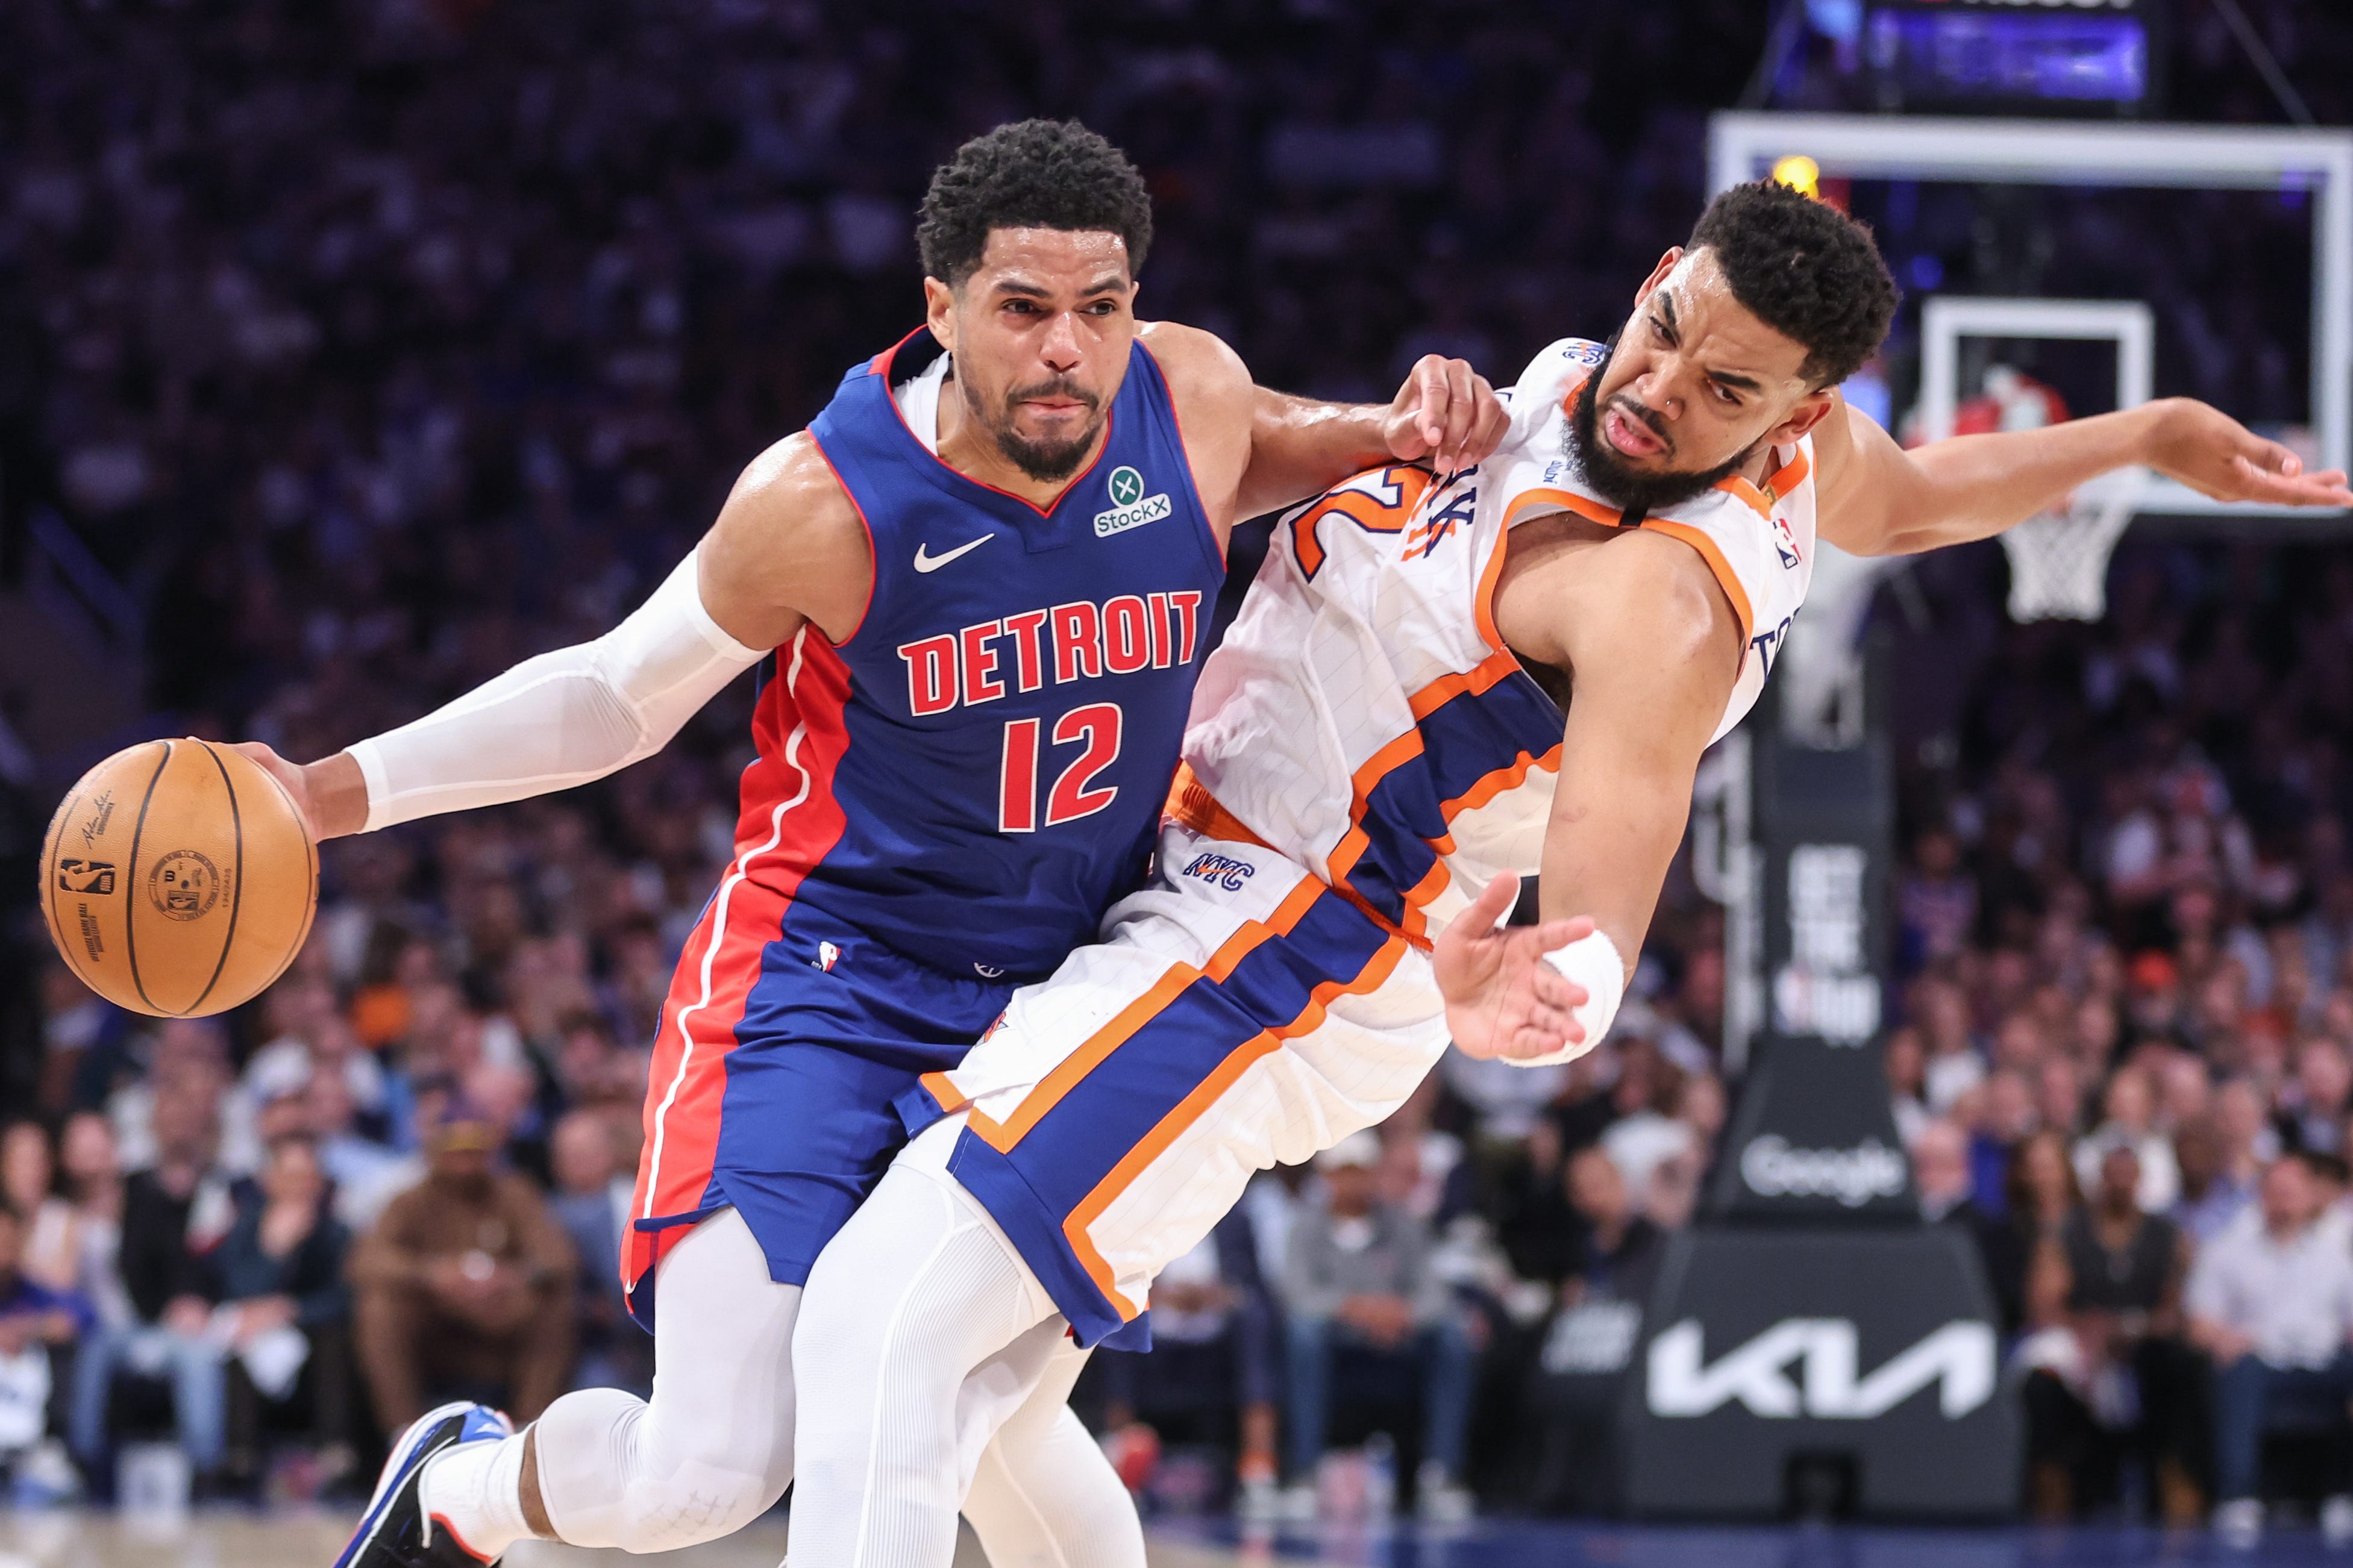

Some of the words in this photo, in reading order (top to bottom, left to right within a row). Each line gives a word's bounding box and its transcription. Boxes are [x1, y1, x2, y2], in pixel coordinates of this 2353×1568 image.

[1097, 498, 1168, 533] StockX
[897, 590, 1202, 717] DETROIT
[998, 702, 1123, 833] 12
[1182, 852, 1255, 892] NYC
